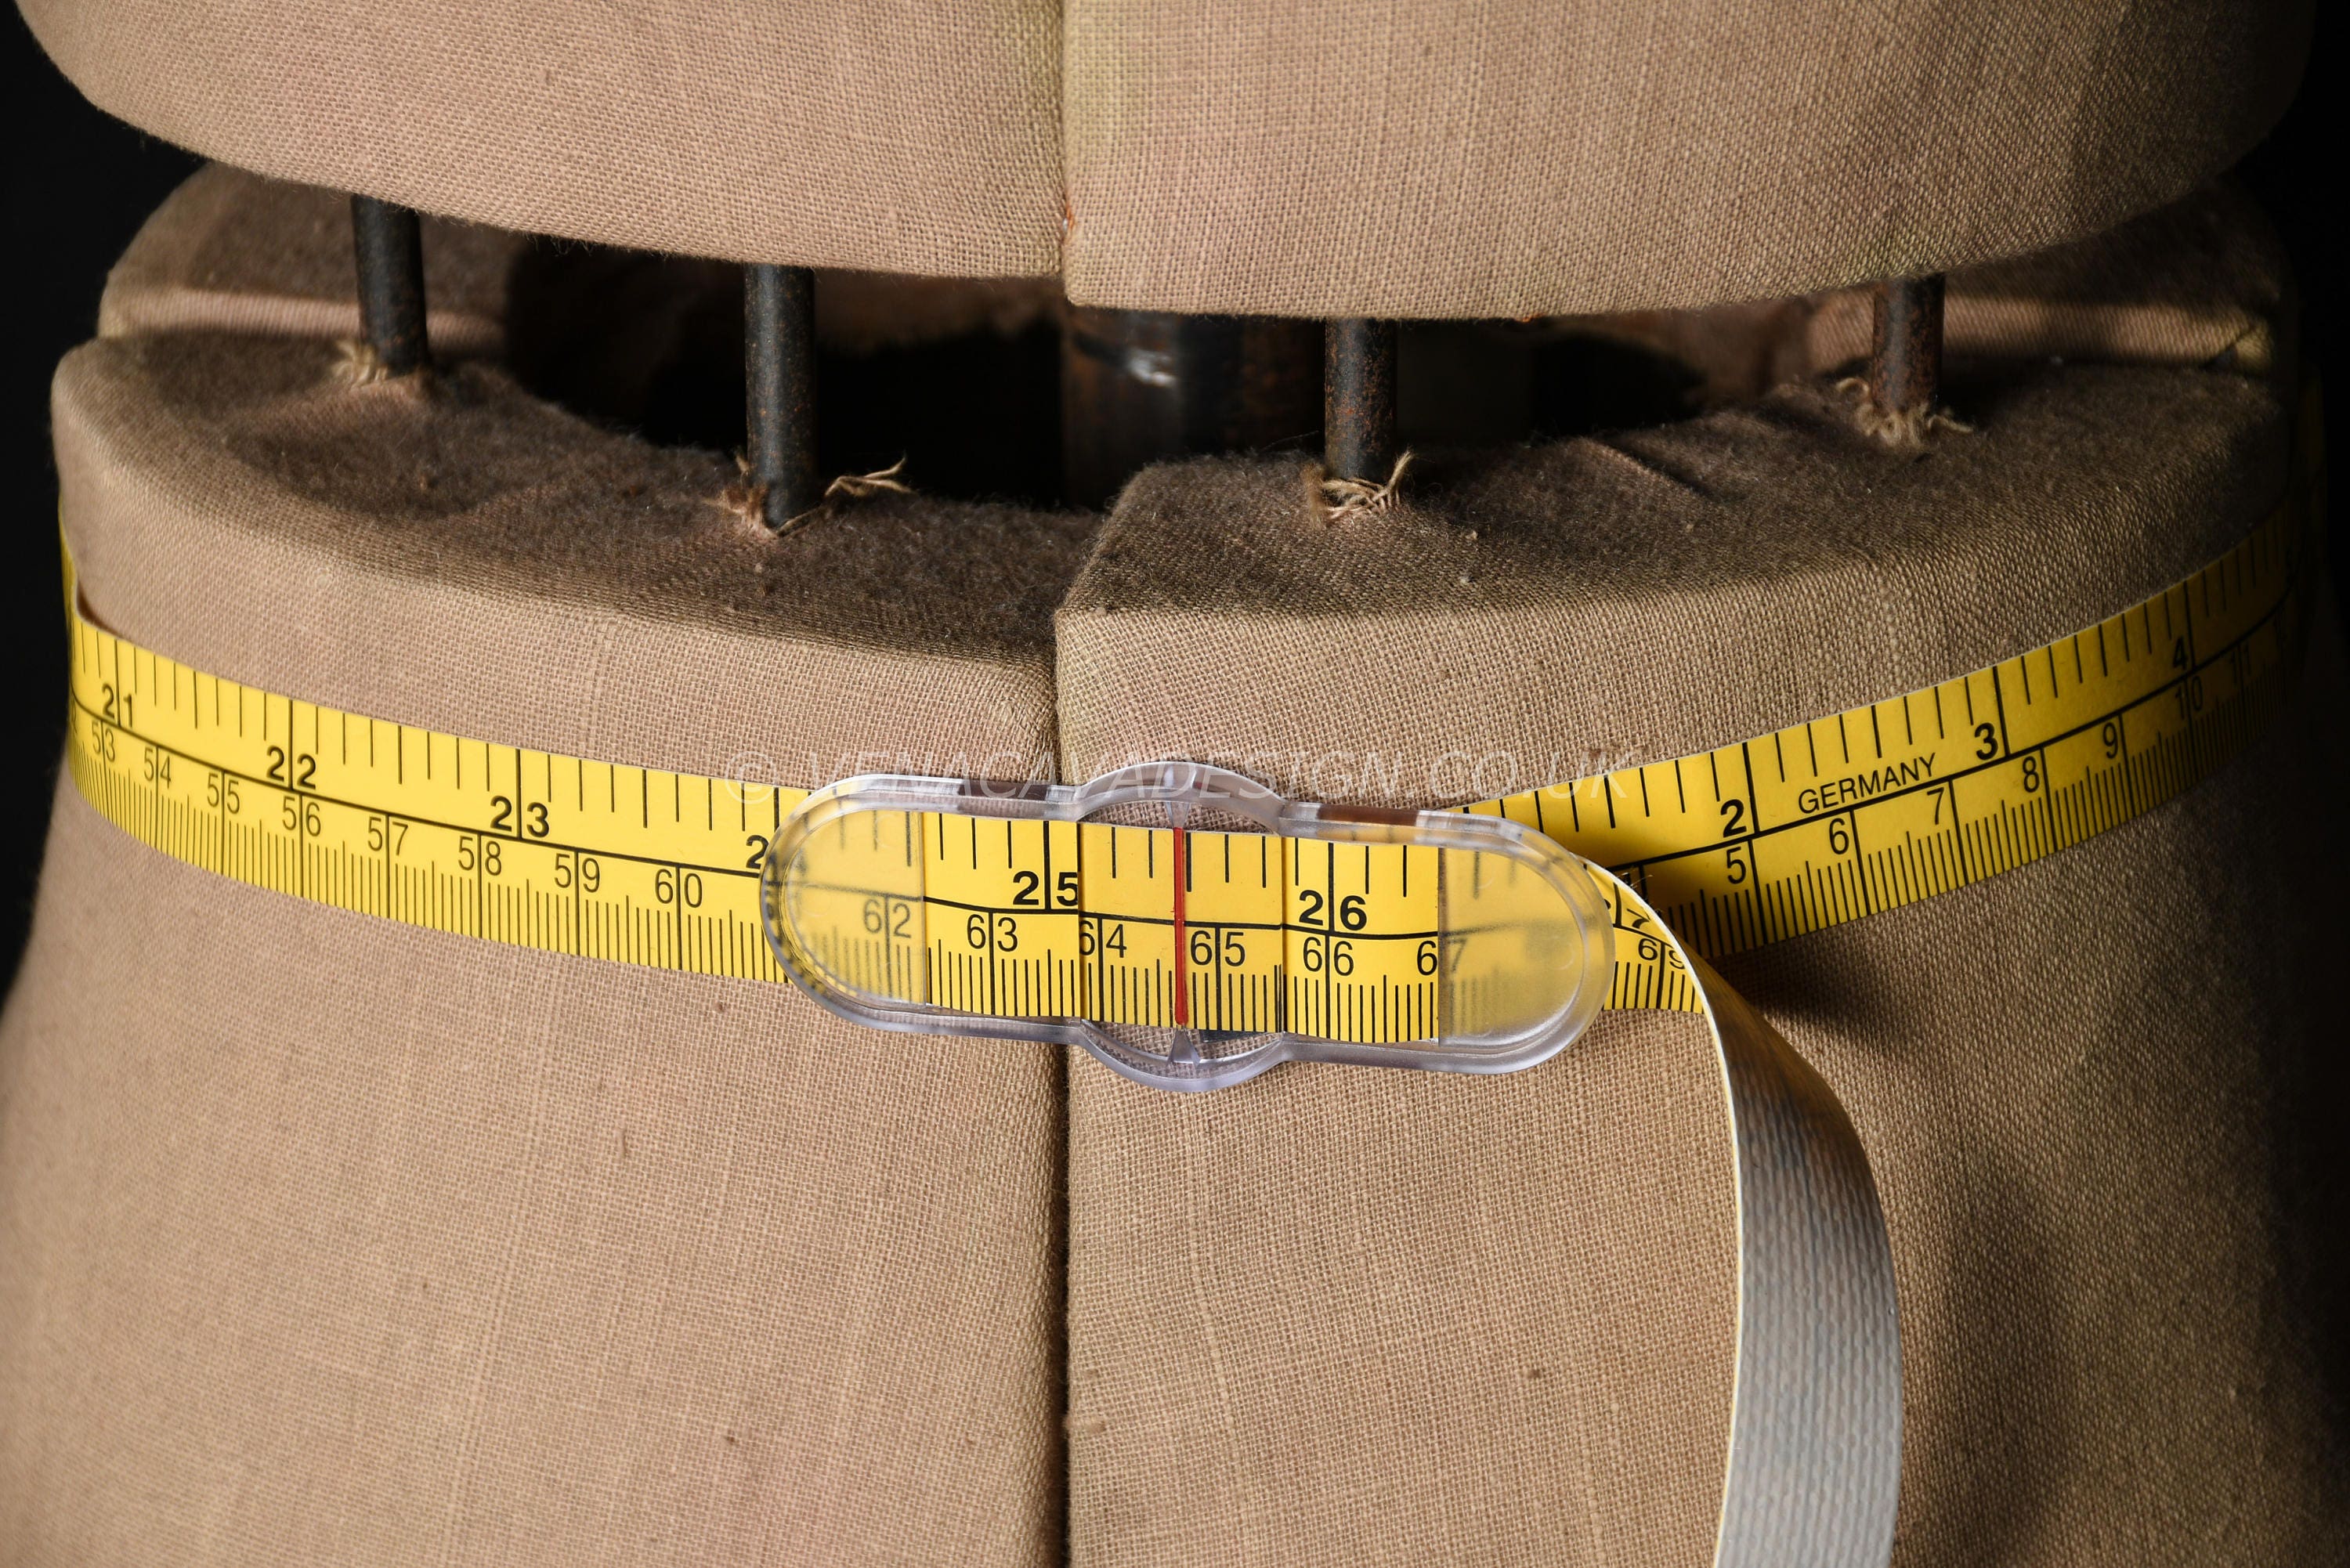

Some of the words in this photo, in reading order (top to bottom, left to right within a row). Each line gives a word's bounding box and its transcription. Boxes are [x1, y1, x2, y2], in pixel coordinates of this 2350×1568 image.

[92, 721, 116, 763] 53
[143, 746, 172, 789] 54
[208, 772, 240, 815] 55
[281, 795, 322, 837] 56
[367, 816, 409, 856] 57
[457, 835, 503, 876] 58
[554, 853, 601, 893] 59
[654, 868, 703, 909] 60
[863, 898, 912, 939] 62
[967, 913, 1018, 952] 63
[1079, 919, 1127, 959] 64
[1190, 930, 1246, 967] 65
[1303, 936, 1354, 977] 66
[102, 683, 133, 728] 21
[266, 746, 317, 790] 22
[490, 795, 550, 838] 23
[1013, 872, 1078, 907] 25
[1299, 889, 1368, 931] 26
[1720, 799, 1747, 838] 2
[1798, 753, 1936, 814] GERMANY
[1974, 722, 1998, 761] 3
[2172, 637, 2187, 670] 4
[1726, 846, 1747, 884] 5
[1828, 818, 1850, 855] 6
[1926, 787, 1946, 826] 7
[2022, 756, 2040, 793] 8
[2103, 722, 2120, 759] 9
[2175, 676, 2204, 720] 10
